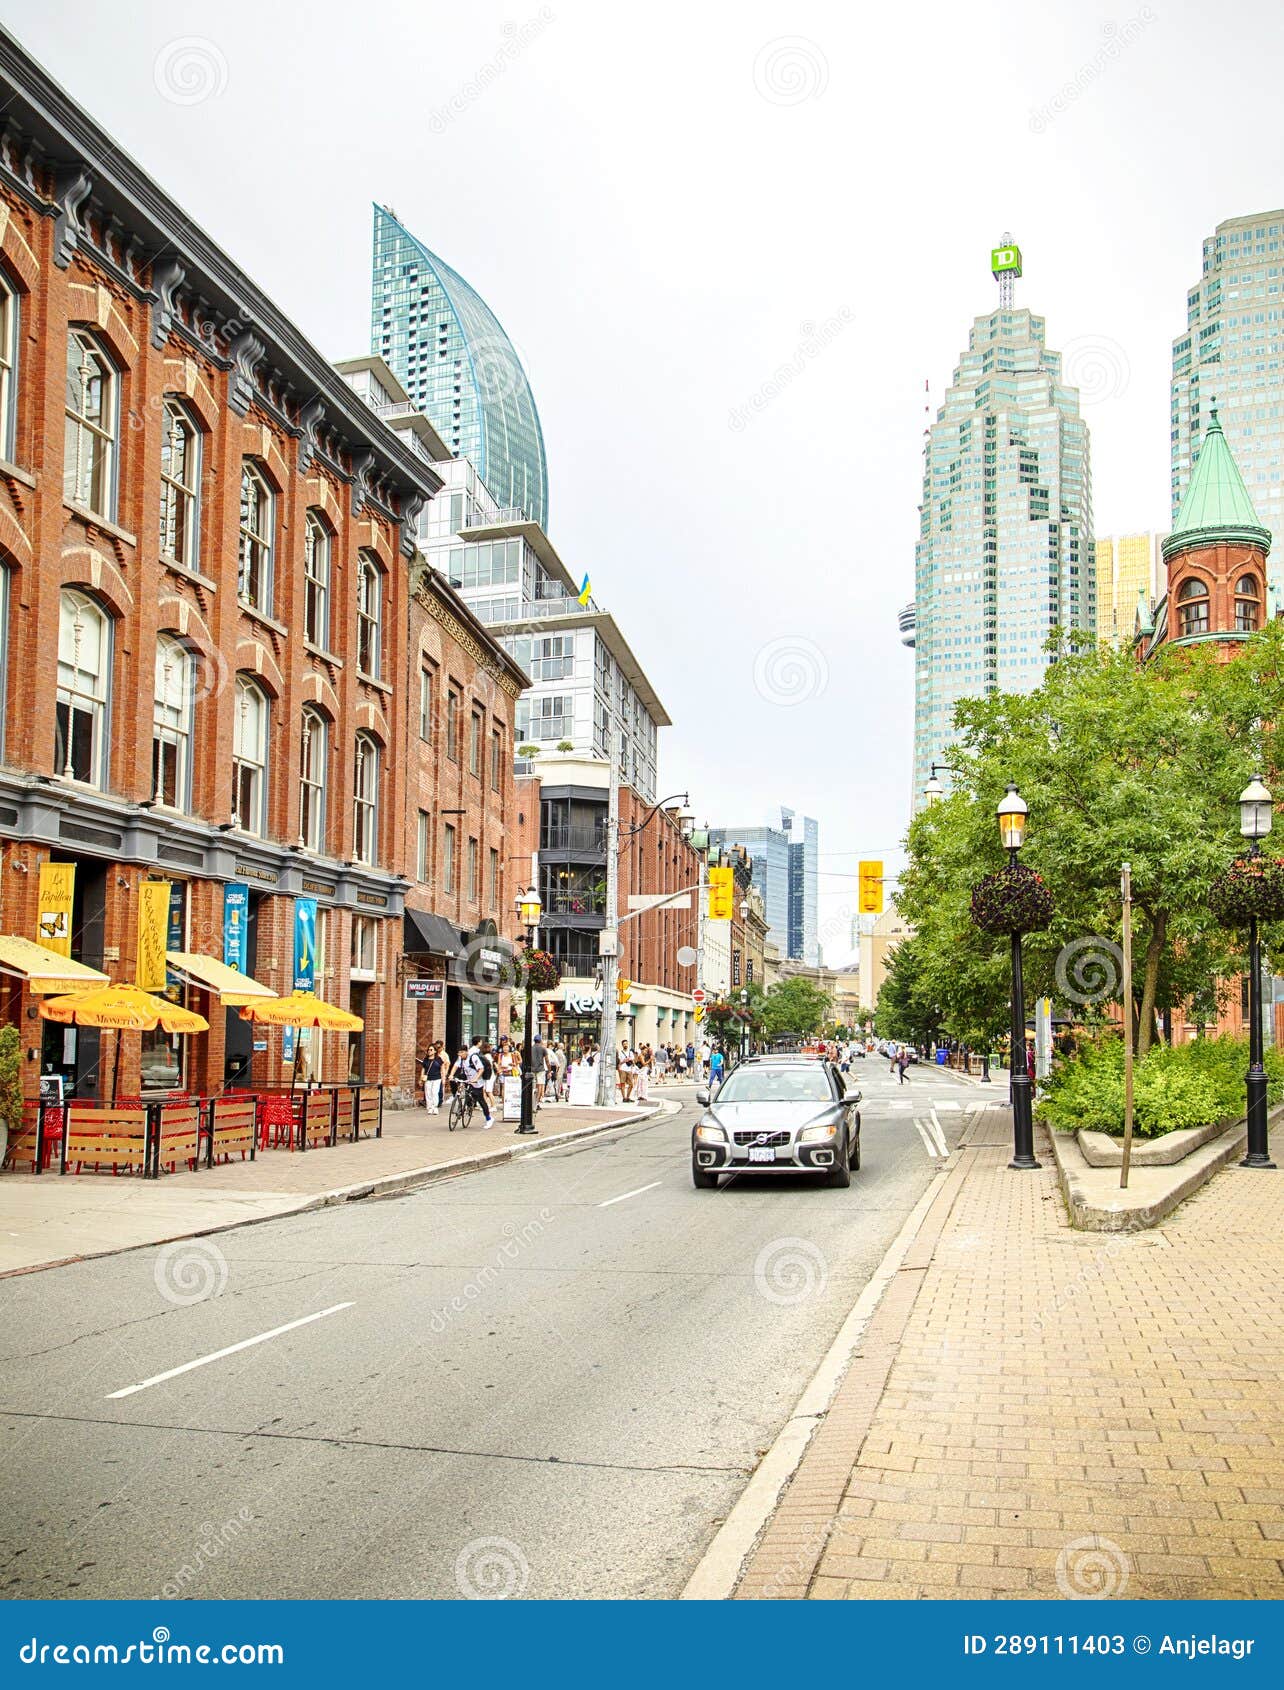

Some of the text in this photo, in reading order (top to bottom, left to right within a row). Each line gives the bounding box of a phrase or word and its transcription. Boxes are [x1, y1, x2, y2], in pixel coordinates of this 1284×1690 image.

[994, 250, 1014, 266] TD
[40, 889, 72, 904] Papillon
[408, 983, 440, 992] WILDLIFE
